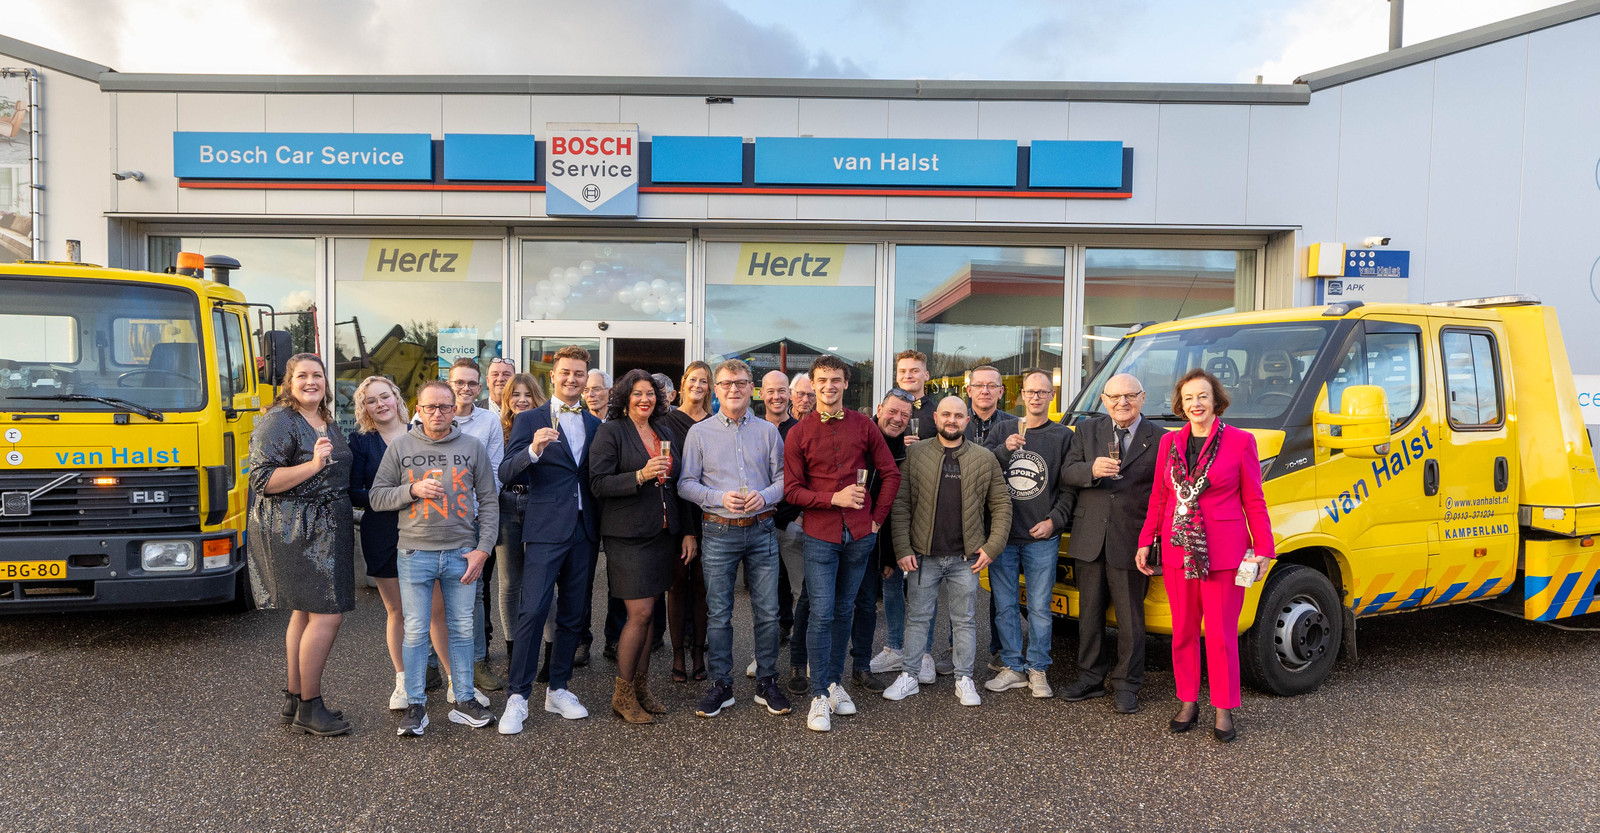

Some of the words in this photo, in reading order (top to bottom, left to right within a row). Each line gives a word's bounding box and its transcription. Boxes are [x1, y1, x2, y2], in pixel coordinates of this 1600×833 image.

[200, 145, 268, 164] Bosch
[276, 146, 314, 164] Car
[321, 146, 404, 165] Service
[552, 136, 632, 156] BOSCH
[551, 160, 632, 177] Service
[833, 156, 872, 170] van
[880, 152, 940, 171] Halst
[377, 248, 458, 272] Hertz
[748, 252, 831, 276] Hertz
[440, 346, 475, 354] Service
[55, 450, 103, 465] van
[112, 446, 180, 464] Halst
[402, 454, 447, 468] CORE
[454, 454, 471, 466] BY
[1010, 470, 1036, 478] SPORT
[1324, 478, 1369, 524] van
[1371, 426, 1434, 488] Halst
[132, 491, 165, 503] FL6
[1454, 495, 1509, 507] www.vanhalst.nl
[1445, 524, 1509, 539] KAMPERLAND
